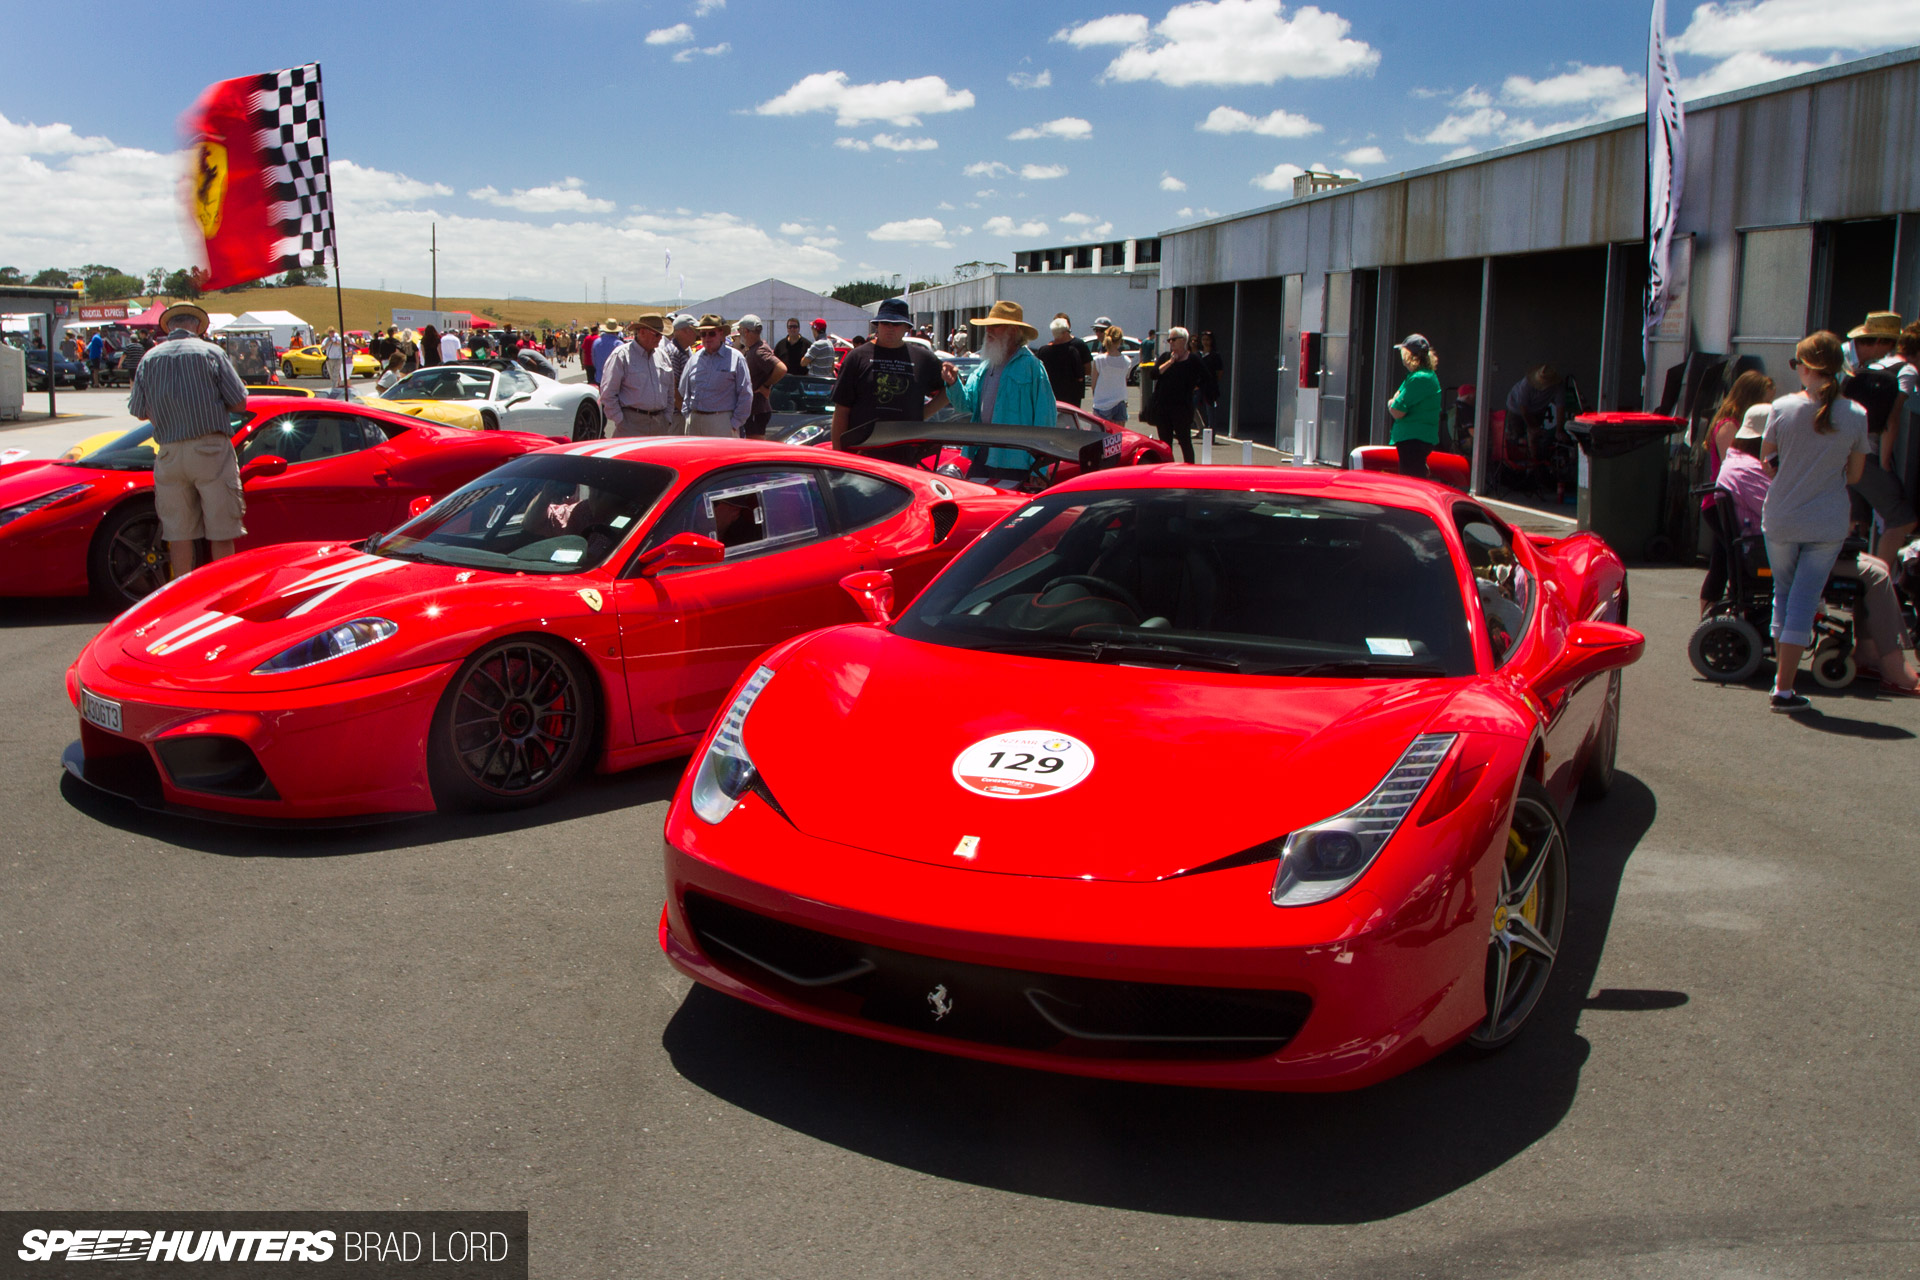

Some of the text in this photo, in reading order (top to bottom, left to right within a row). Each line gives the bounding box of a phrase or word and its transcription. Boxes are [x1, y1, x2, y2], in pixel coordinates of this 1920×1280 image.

[1104, 434, 1121, 448] LIQUI
[1104, 443, 1121, 457] MOLY
[988, 751, 1064, 774] 129
